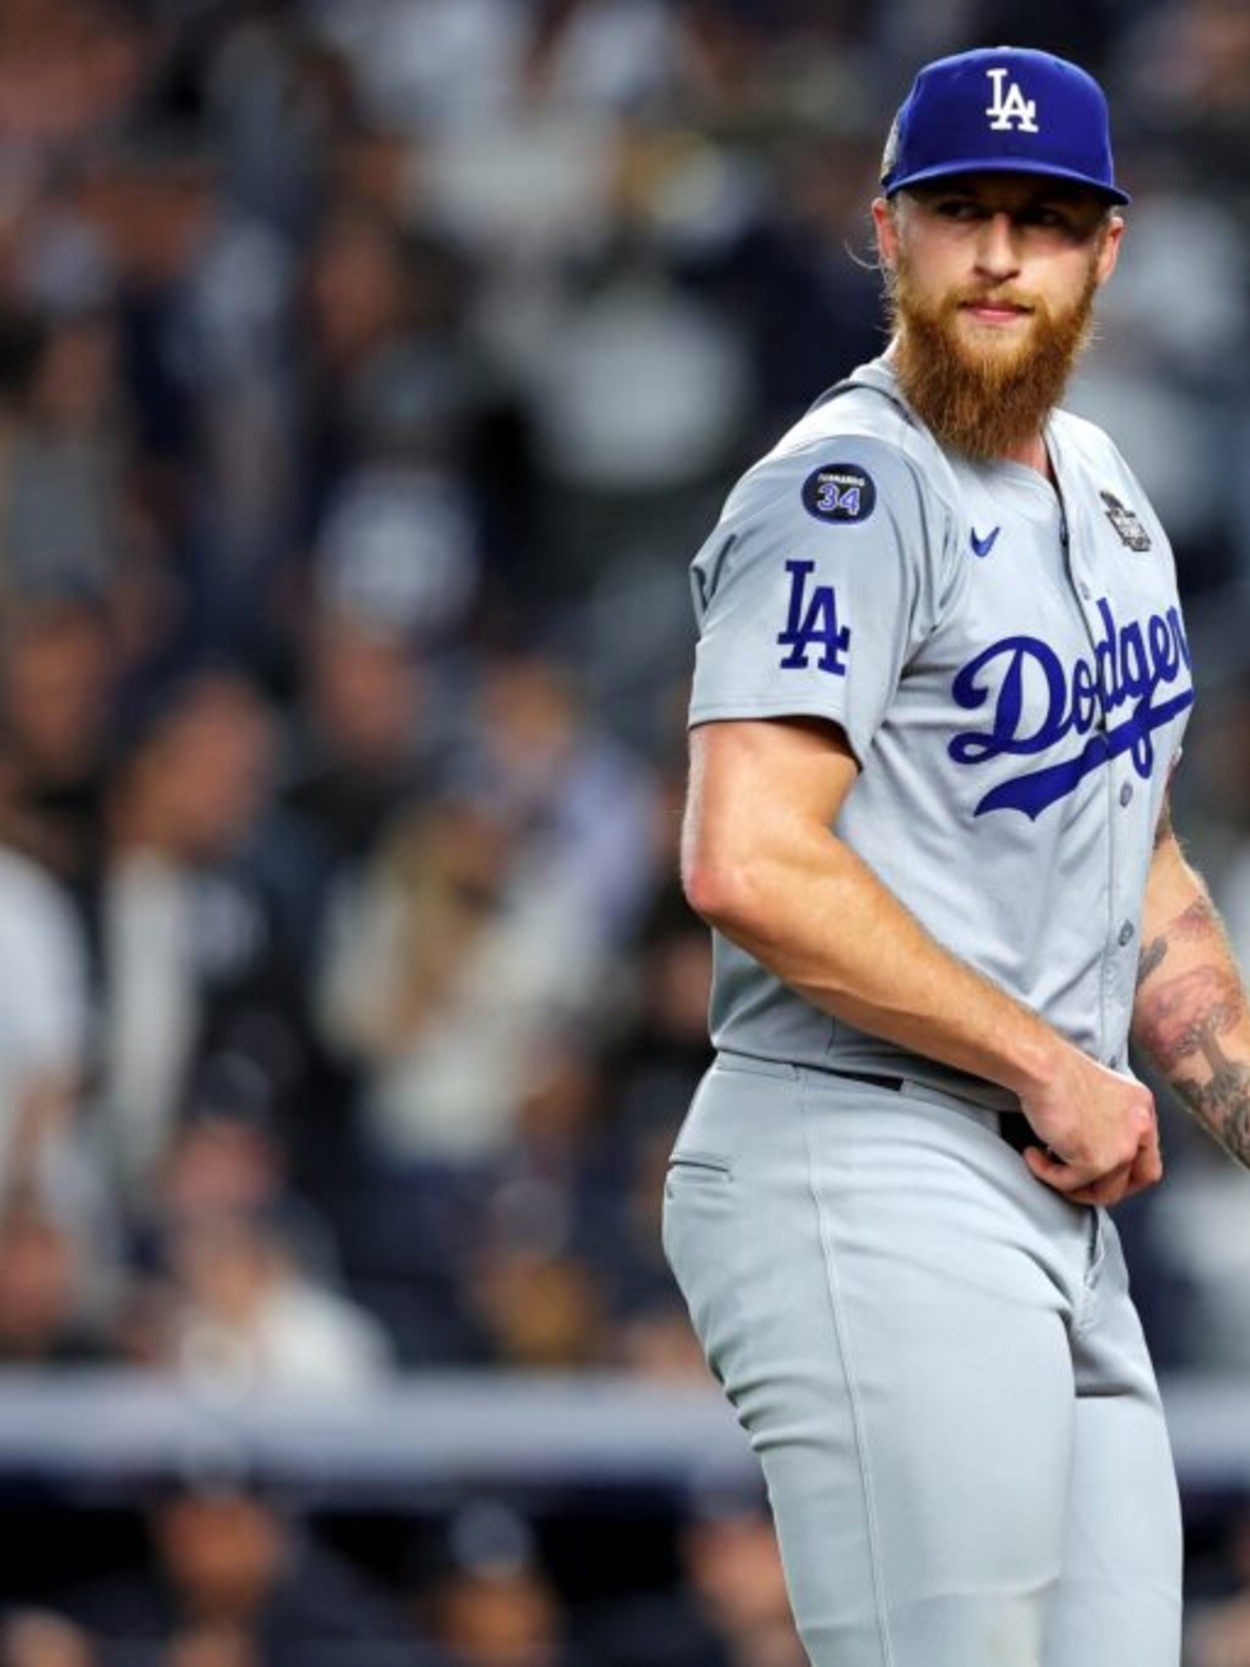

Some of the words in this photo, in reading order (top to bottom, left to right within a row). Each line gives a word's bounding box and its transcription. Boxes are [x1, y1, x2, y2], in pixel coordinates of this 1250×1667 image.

[985, 68, 1039, 132] LA
[817, 482, 861, 516] 34
[777, 560, 850, 676] LA
